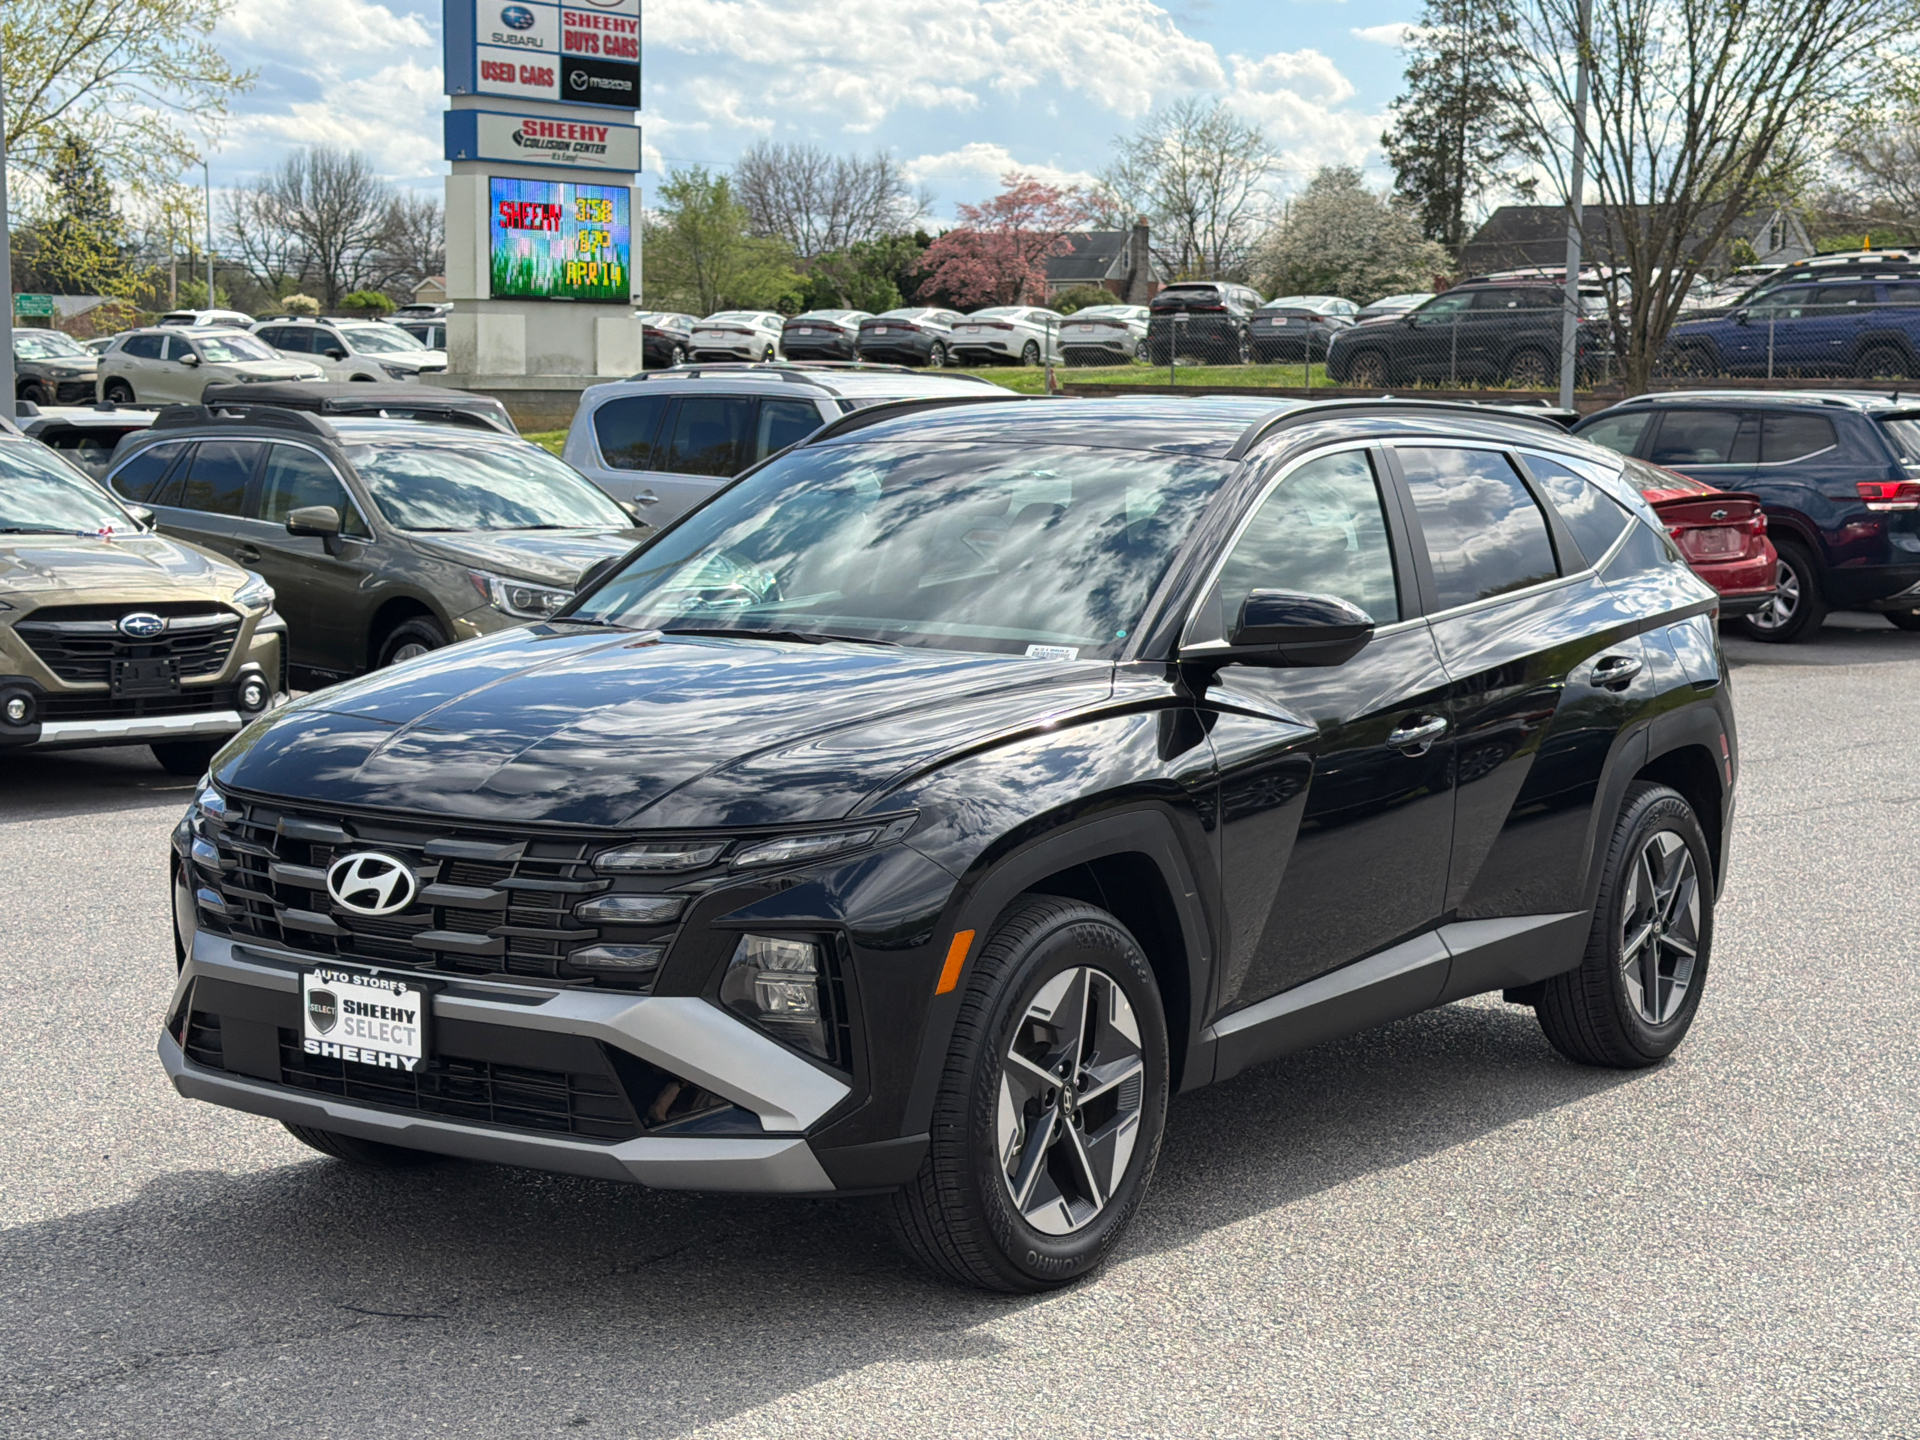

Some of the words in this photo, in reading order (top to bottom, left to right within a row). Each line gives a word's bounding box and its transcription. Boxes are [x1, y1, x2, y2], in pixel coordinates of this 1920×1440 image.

[563, 11, 638, 34] SHEEHY
[491, 32, 544, 48] SUBARU
[564, 29, 600, 54] BUYS
[603, 35, 638, 59] CARS
[481, 60, 516, 83] USED
[519, 64, 554, 87] CARS
[589, 76, 633, 91] mazda
[522, 119, 609, 143] SHEEHY
[523, 138, 571, 152] COLLISION
[572, 141, 607, 154] CENTER
[499, 200, 562, 232] SHEEHY
[575, 197, 613, 223] 3:58
[566, 261, 599, 286] APR
[602, 262, 621, 287] 14
[313, 968, 349, 983] AUTO
[352, 974, 407, 993] STORES
[310, 1003, 336, 1016] SELECT
[343, 999, 416, 1025] SHEEHY
[344, 1016, 416, 1047] SELECT
[303, 1039, 419, 1072] SHEEHY
[1026, 1250, 1085, 1274] KUMHO
